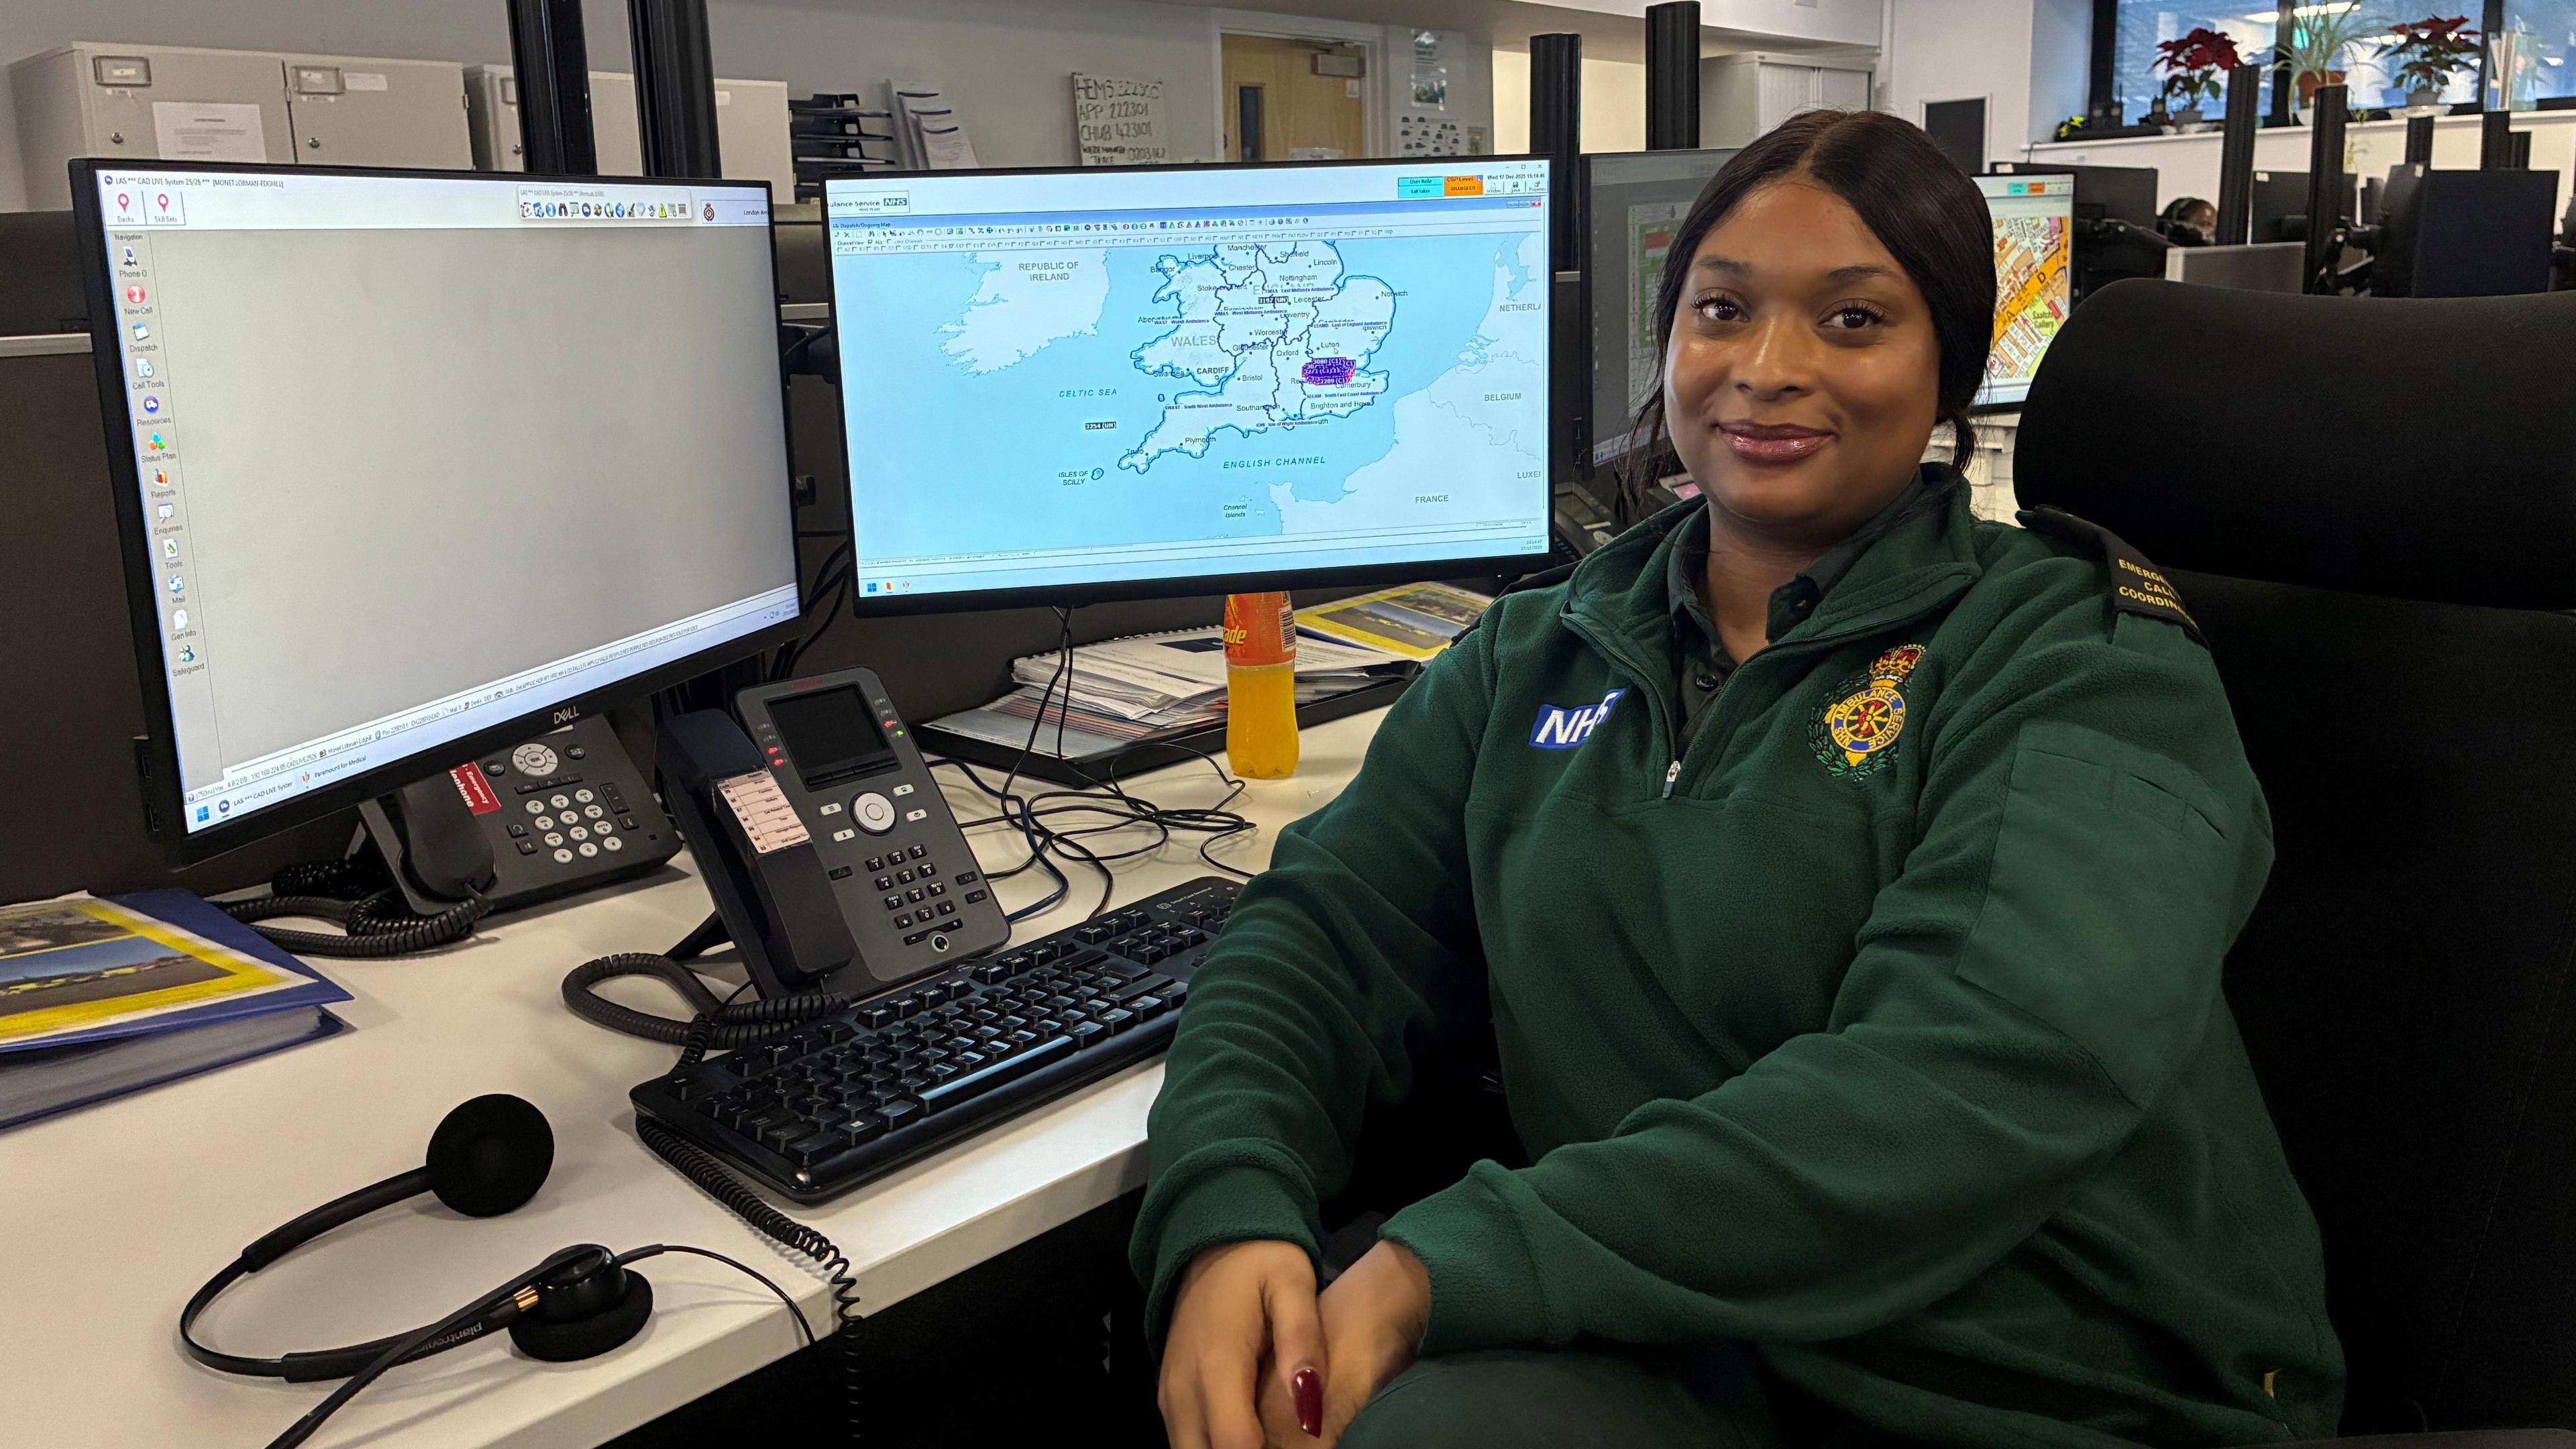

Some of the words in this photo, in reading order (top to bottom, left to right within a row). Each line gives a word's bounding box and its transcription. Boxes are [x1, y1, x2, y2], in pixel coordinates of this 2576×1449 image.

[1079, 103, 1104, 121] APP
[1019, 262, 1065, 271] REPUBLIC
[1067, 262, 1079, 270] OF
[119, 269, 140, 278] Phone
[1030, 273, 1069, 281] IRELAND
[140, 306, 153, 315] Call
[1171, 335, 1217, 347] WALES
[129, 343, 158, 353] Dispatch
[1197, 367, 1229, 375] CARDIFF
[133, 380, 146, 390] Call
[146, 380, 165, 388] Tools
[1059, 390, 1094, 398] CELTIC
[1098, 388, 1118, 396] SEA
[1484, 393, 1521, 402] BELGIUM
[1311, 402, 1338, 411] Brighton
[136, 417, 171, 427] Resources
[1185, 437, 1216, 445] Plymouth
[141, 454, 160, 464] Status
[162, 452, 177, 461] Plan
[1223, 459, 1271, 469] ENGLISH
[1276, 456, 1326, 467] CHANNEL
[1517, 471, 1541, 479] LUXE
[150, 489, 176, 499] Reports
[1415, 495, 1449, 504] FRANCE
[154, 524, 183, 535] Enquiries
[164, 559, 183, 569] Tools
[2145, 581, 2176, 599] CALL
[172, 595, 186, 604] Mail
[171, 632, 183, 641] Gen
[184, 629, 197, 638] Info
[172, 662, 205, 677] Safeguard
[1835, 689, 1898, 720] AMBULANCE
[554, 704, 580, 724] DELL
[1535, 690, 1623, 745] NHS
[1868, 708, 1904, 749] SERVICE
[1834, 726, 1854, 747] NHS
[233, 797, 244, 806] LAS
[253, 790, 265, 800] CAD
[266, 786, 278, 796] LIVE
[315, 765, 340, 778] Paramount
[348, 755, 367, 767] Medical
[466, 771, 490, 804] Emergency
[423, 1321, 484, 1351] plantroni
